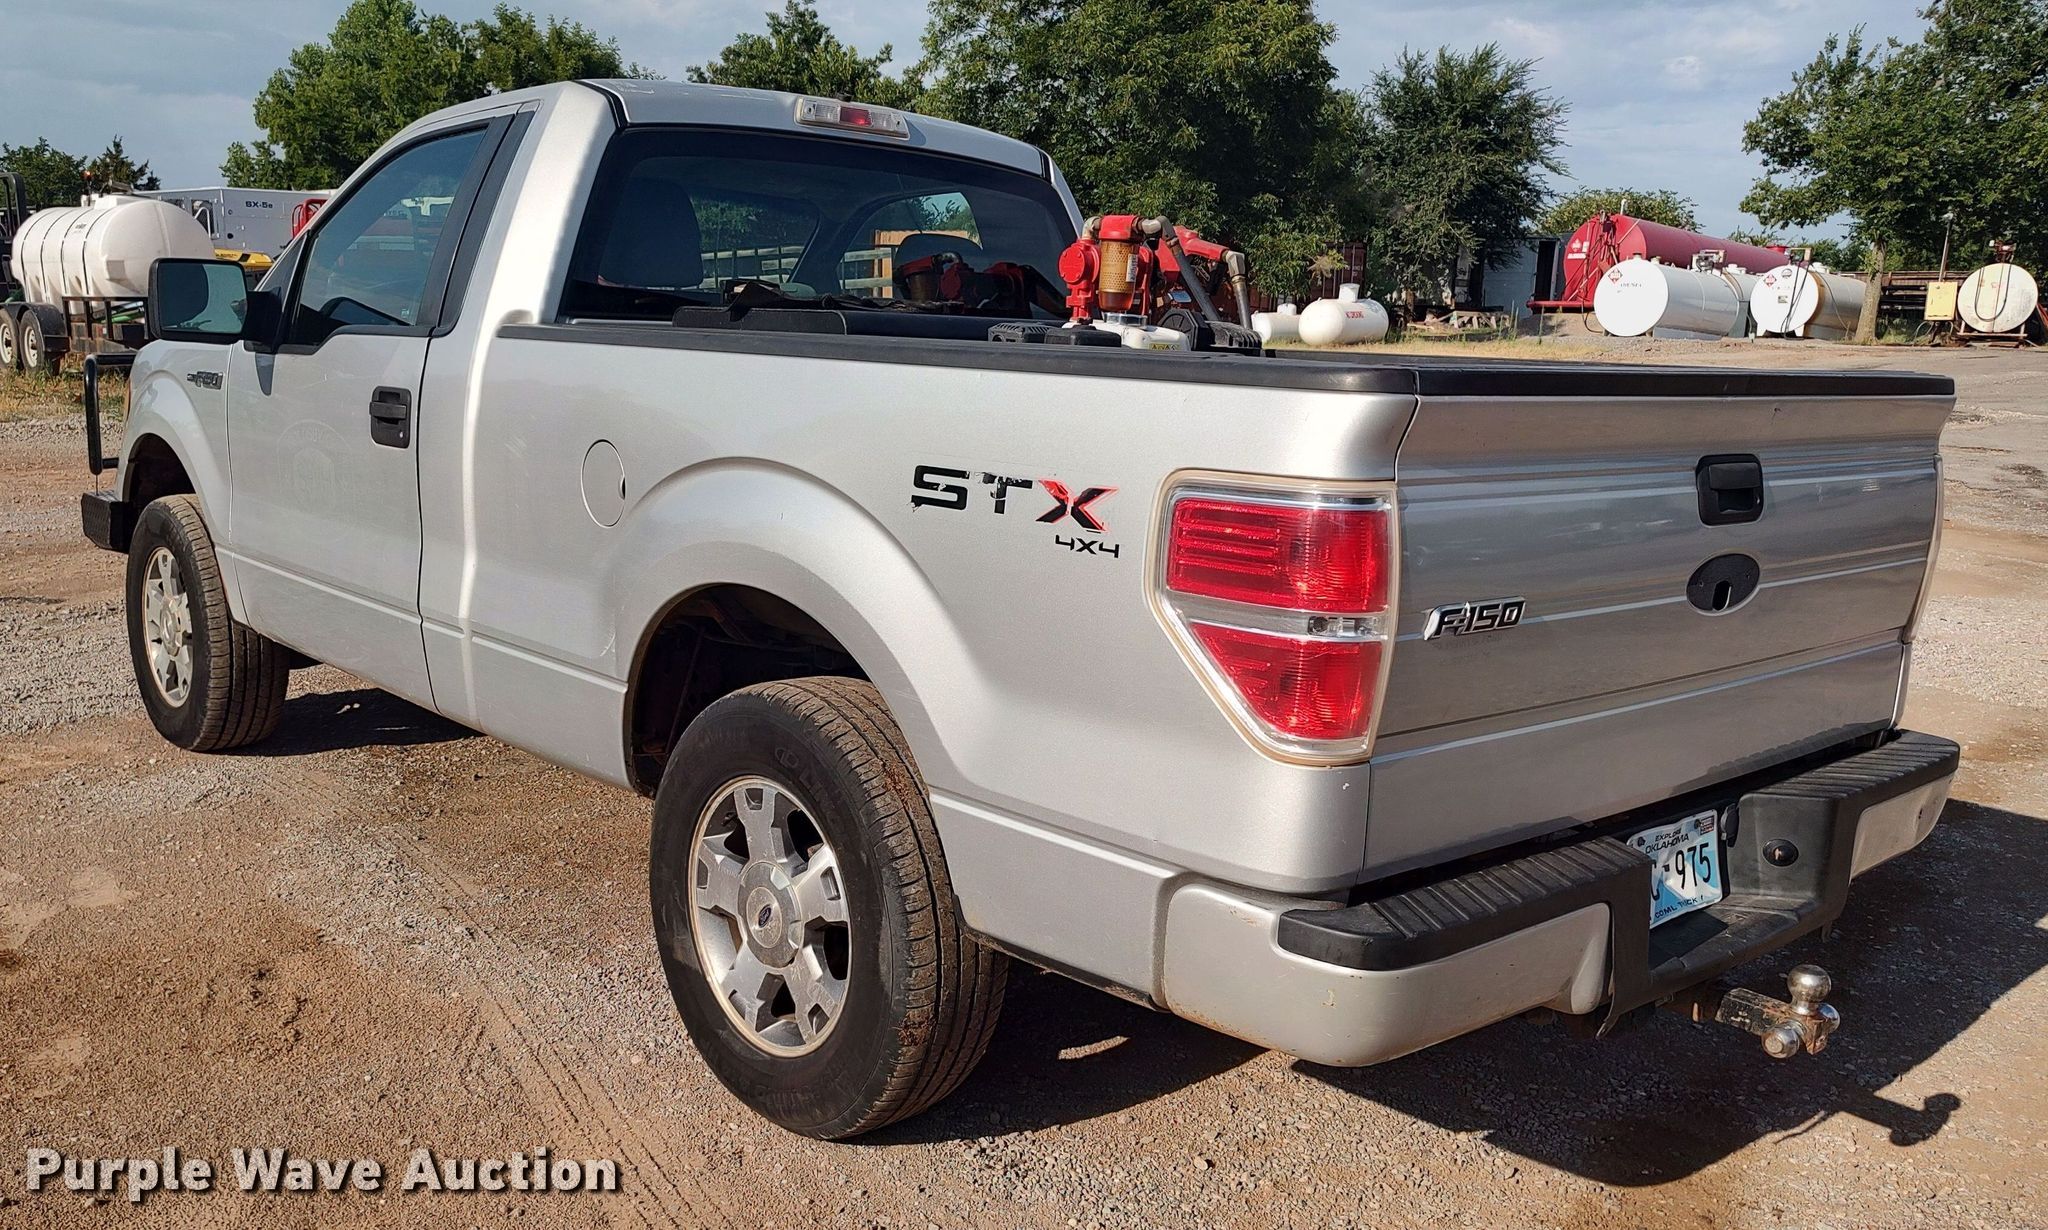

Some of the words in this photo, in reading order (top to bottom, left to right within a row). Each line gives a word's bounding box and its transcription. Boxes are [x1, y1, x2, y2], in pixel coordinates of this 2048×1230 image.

[906, 464, 1120, 532] STX
[1645, 833, 1689, 853] OKLAHOMA
[1675, 842, 1711, 889] 975
